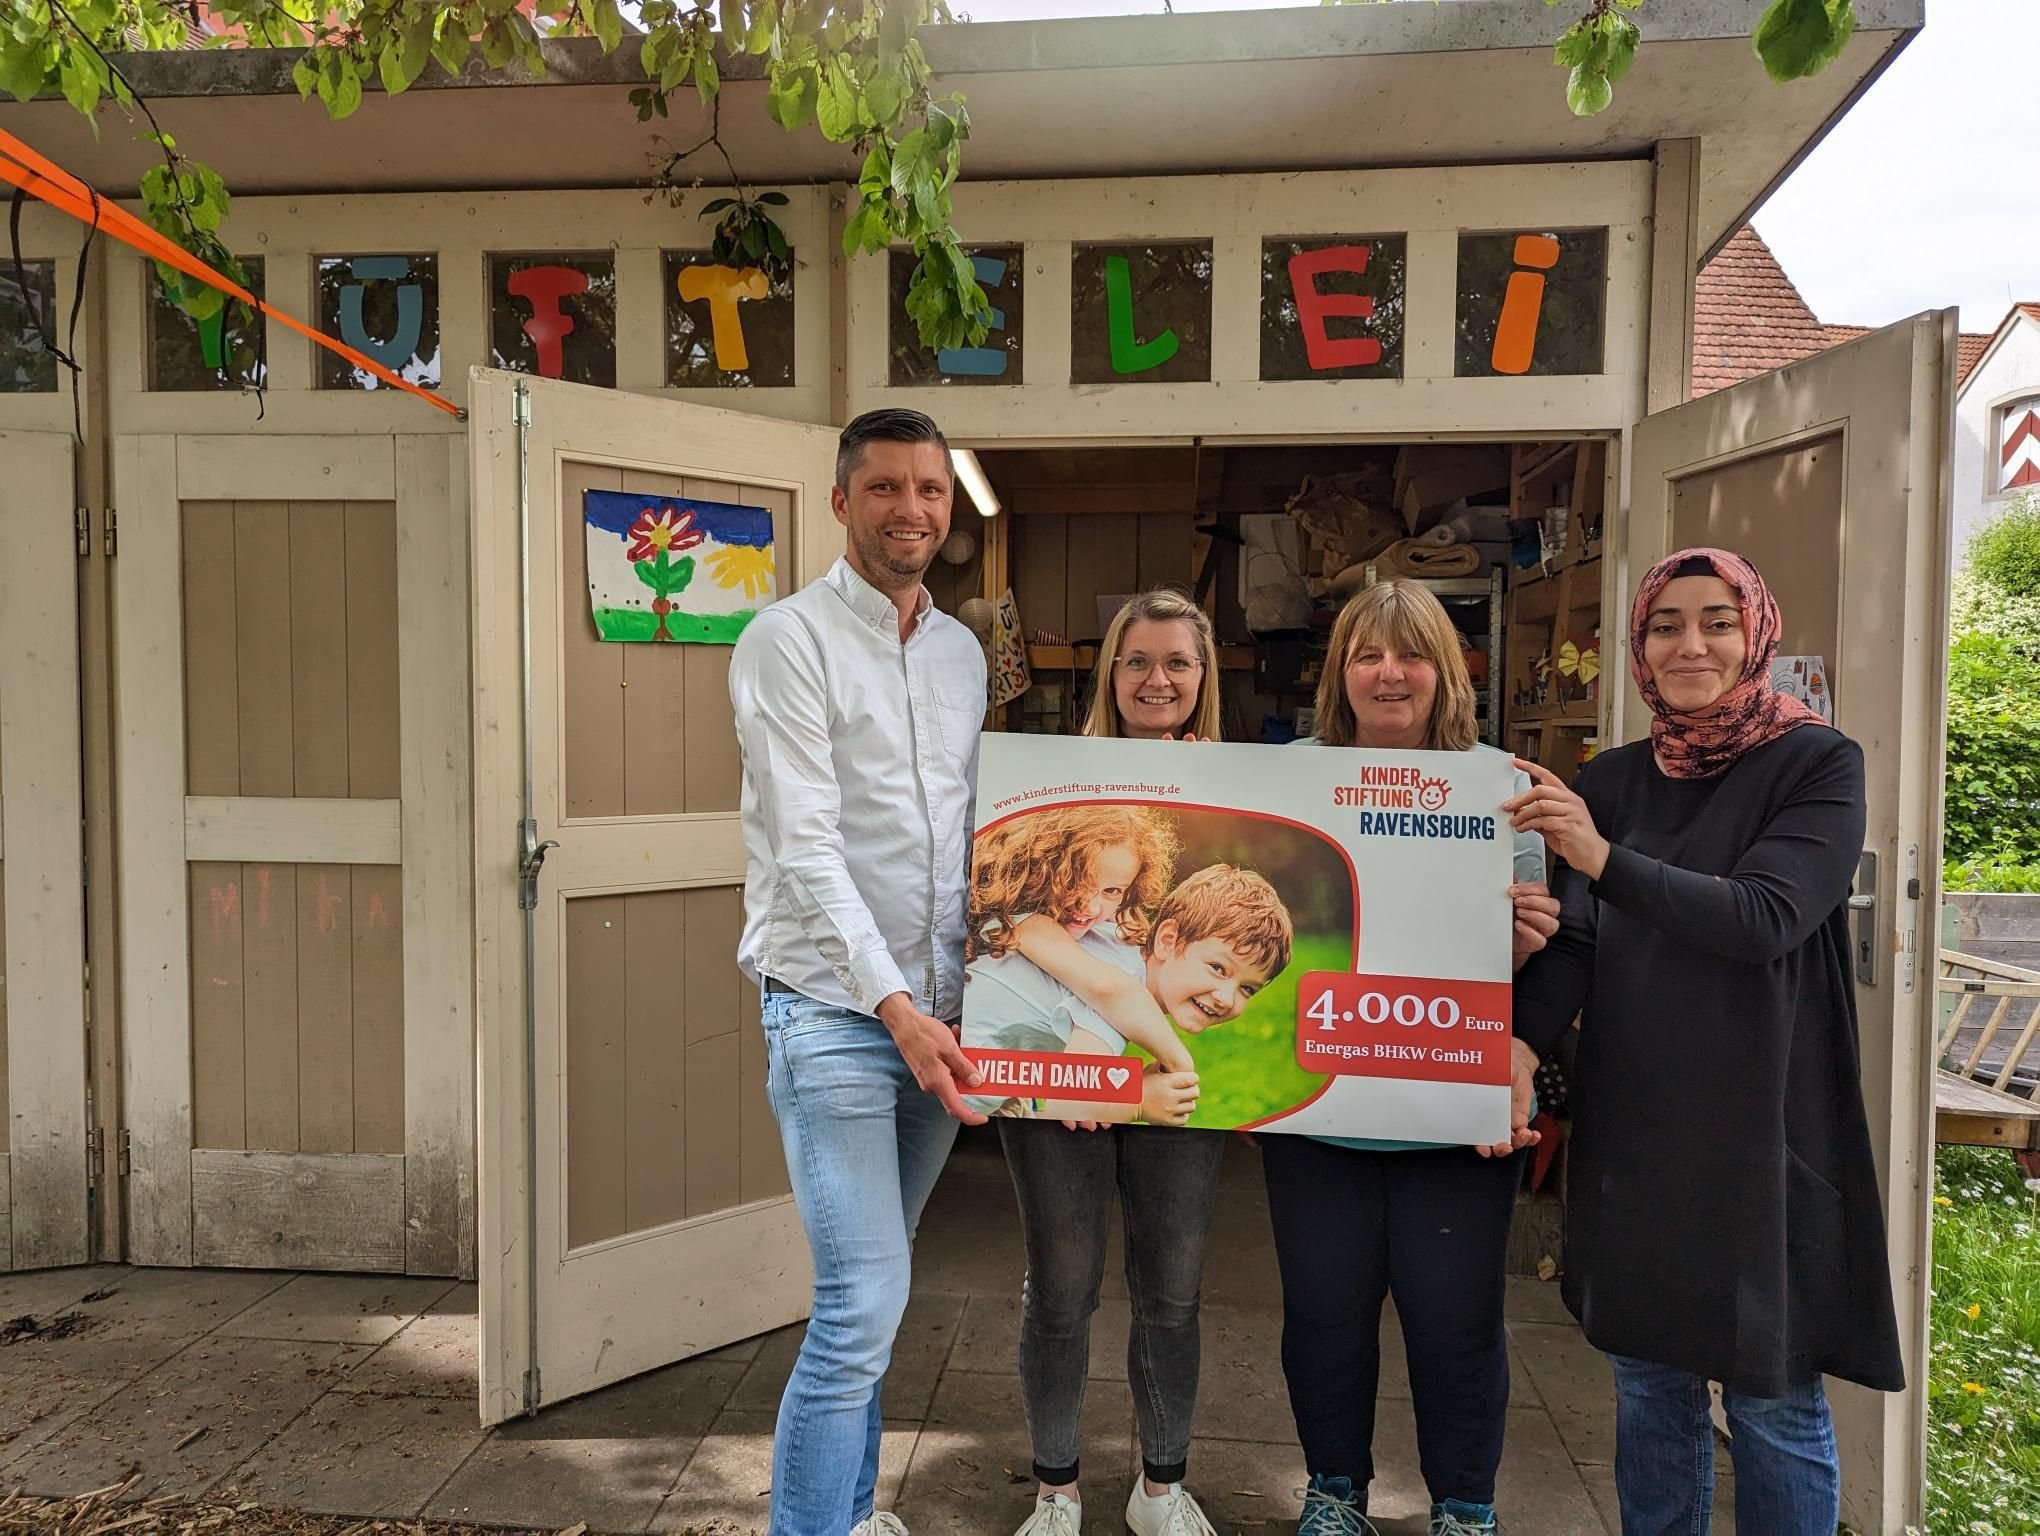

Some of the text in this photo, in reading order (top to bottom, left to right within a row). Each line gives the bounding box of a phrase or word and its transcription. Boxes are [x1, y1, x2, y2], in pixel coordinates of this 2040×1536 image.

[1360, 766, 1421, 787] KINDER
[993, 783, 1180, 810] www.kinderstiftung-ravensburg.de
[1333, 786, 1413, 809] STIFTUNG
[1360, 811, 1495, 841] RAVENSBURG
[1306, 989, 1505, 1032] 4.000 Euro
[1304, 1039, 1483, 1065] Energas BHKW GmbH
[977, 1059, 1102, 1090] VIELEN DANK
